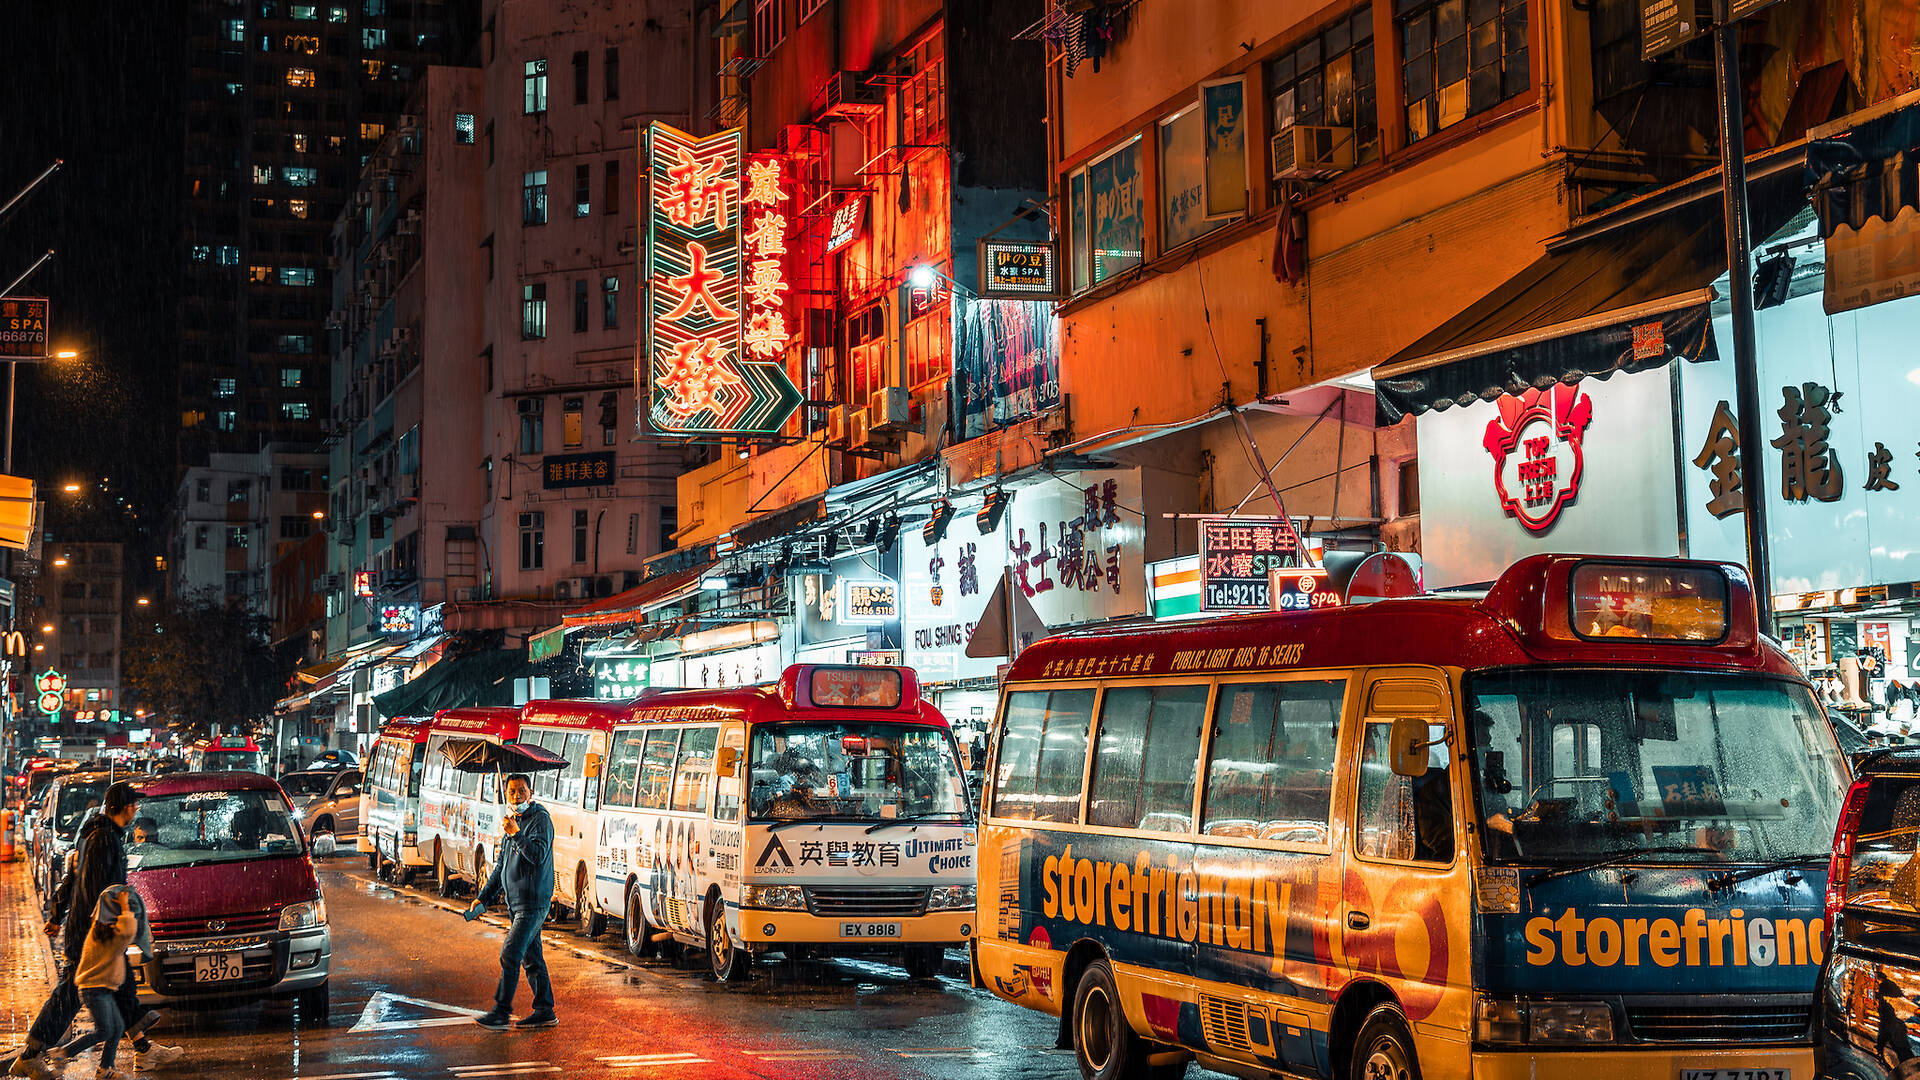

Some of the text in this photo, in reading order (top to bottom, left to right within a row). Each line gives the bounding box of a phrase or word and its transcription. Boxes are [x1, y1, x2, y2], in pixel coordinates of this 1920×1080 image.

[997, 251, 1042, 267] 伊の豆
[1021, 268, 1040, 276] SPA
[655, 146, 741, 417] 新大發
[10, 319, 43, 330] SPA
[0, 330, 44, 342] 66876
[1523, 436, 1550, 460] TOP
[1692, 382, 1844, 520] 金龍
[549, 460, 609, 483] 雅軒美容
[1207, 527, 1297, 551] 汪旺養生
[851, 606, 895, 615] 3486 5118
[914, 628, 933, 650] FOU
[935, 624, 962, 647] SHING
[1042, 643, 1305, 677] 公共小型巴士十六座位 PUBLIC LIGHT BUS 16 SEATS
[825, 671, 858, 682] TSUEN
[799, 840, 901, 867] 英譽教育
[905, 838, 963, 858] ULTIMATE
[754, 866, 795, 874] LEADING ACE
[928, 855, 971, 874] CHOICE
[845, 924, 896, 936] EX 8818
[209, 955, 229, 968] UR
[200, 966, 240, 981] 2870
